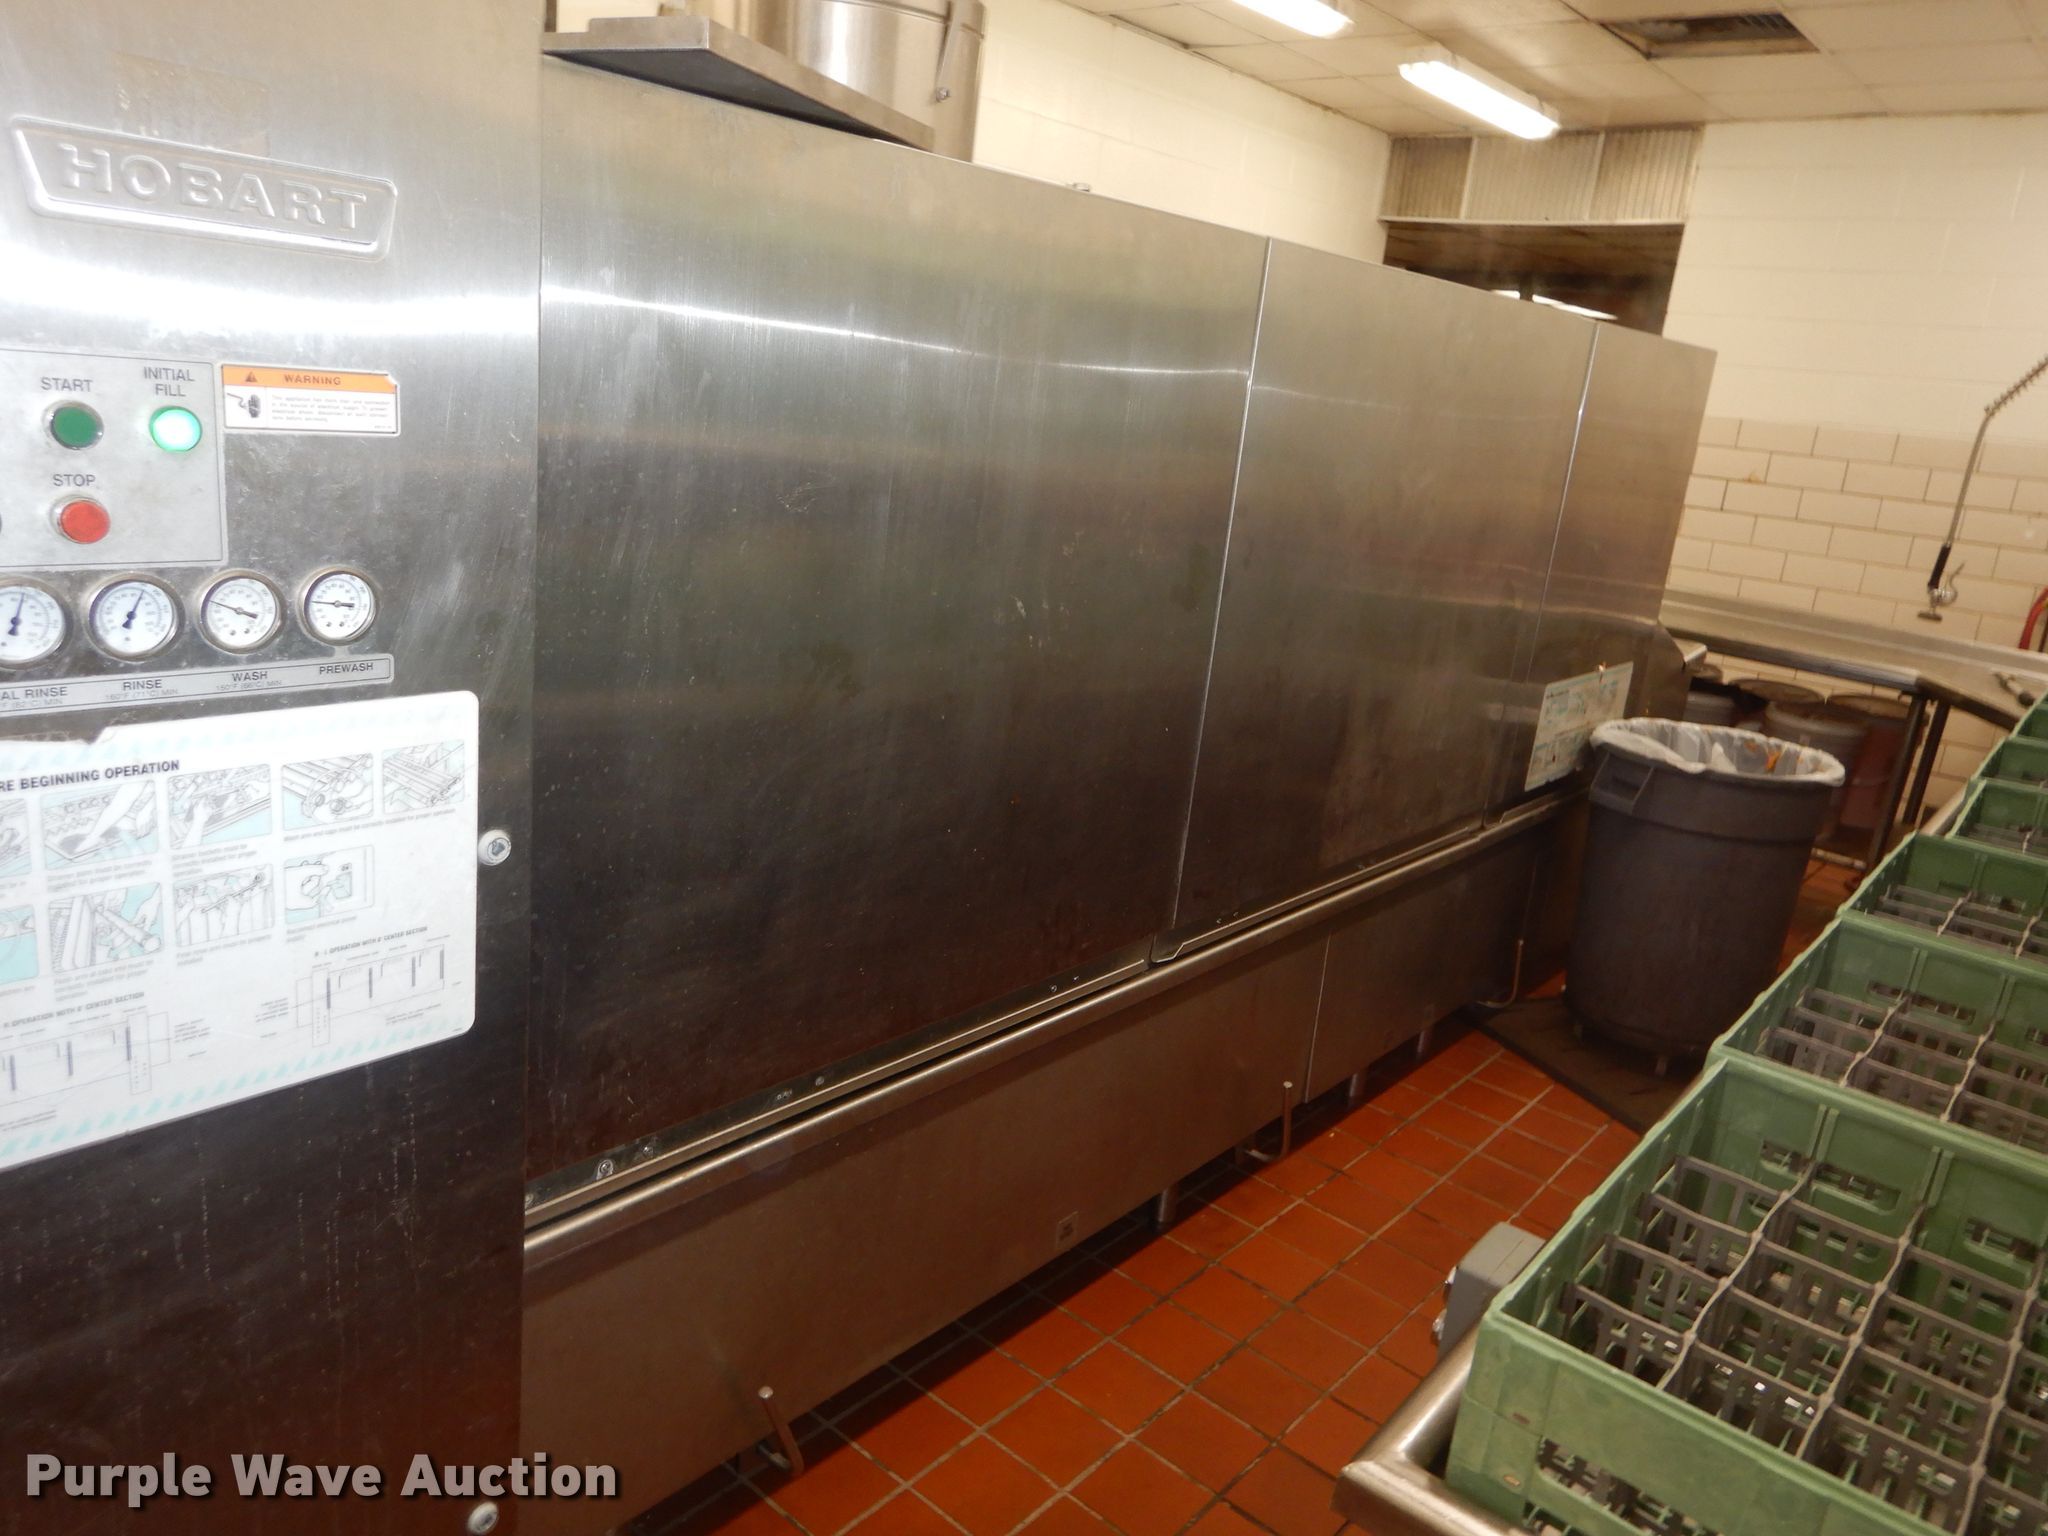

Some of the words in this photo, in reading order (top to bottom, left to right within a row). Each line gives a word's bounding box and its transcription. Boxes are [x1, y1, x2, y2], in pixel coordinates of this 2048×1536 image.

[56, 143, 367, 230] HOBART
[143, 366, 196, 383] INITIAL
[284, 373, 342, 386] WARNING
[40, 377, 94, 393] START
[155, 383, 187, 398] FILL
[53, 473, 96, 487] STOP
[319, 662, 374, 675] PREWASH
[232, 670, 268, 683] WASH
[25, 686, 68, 698] RINSE
[123, 679, 163, 691] RINSE
[20, 769, 100, 790] BEGINNING
[104, 760, 180, 779] OPERATION
